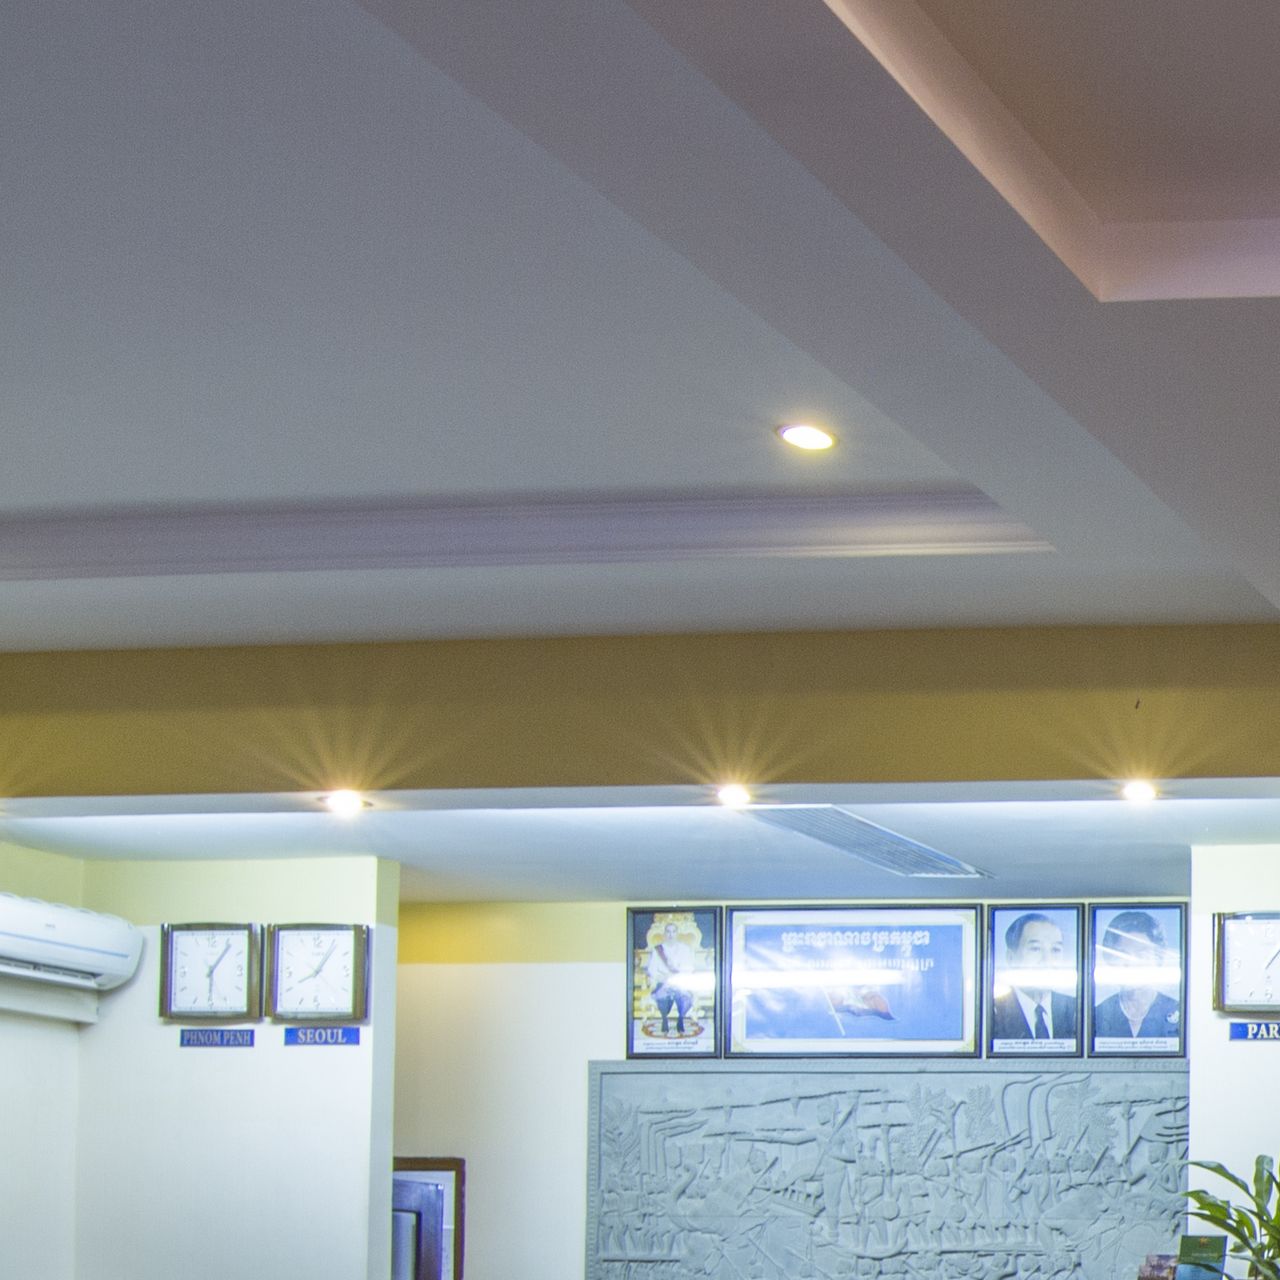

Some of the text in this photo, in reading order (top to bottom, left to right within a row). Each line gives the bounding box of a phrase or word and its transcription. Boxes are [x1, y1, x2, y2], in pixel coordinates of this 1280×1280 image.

[183, 1031, 250, 1045] PHNOM PENH
[297, 1028, 347, 1043] SEOUL
